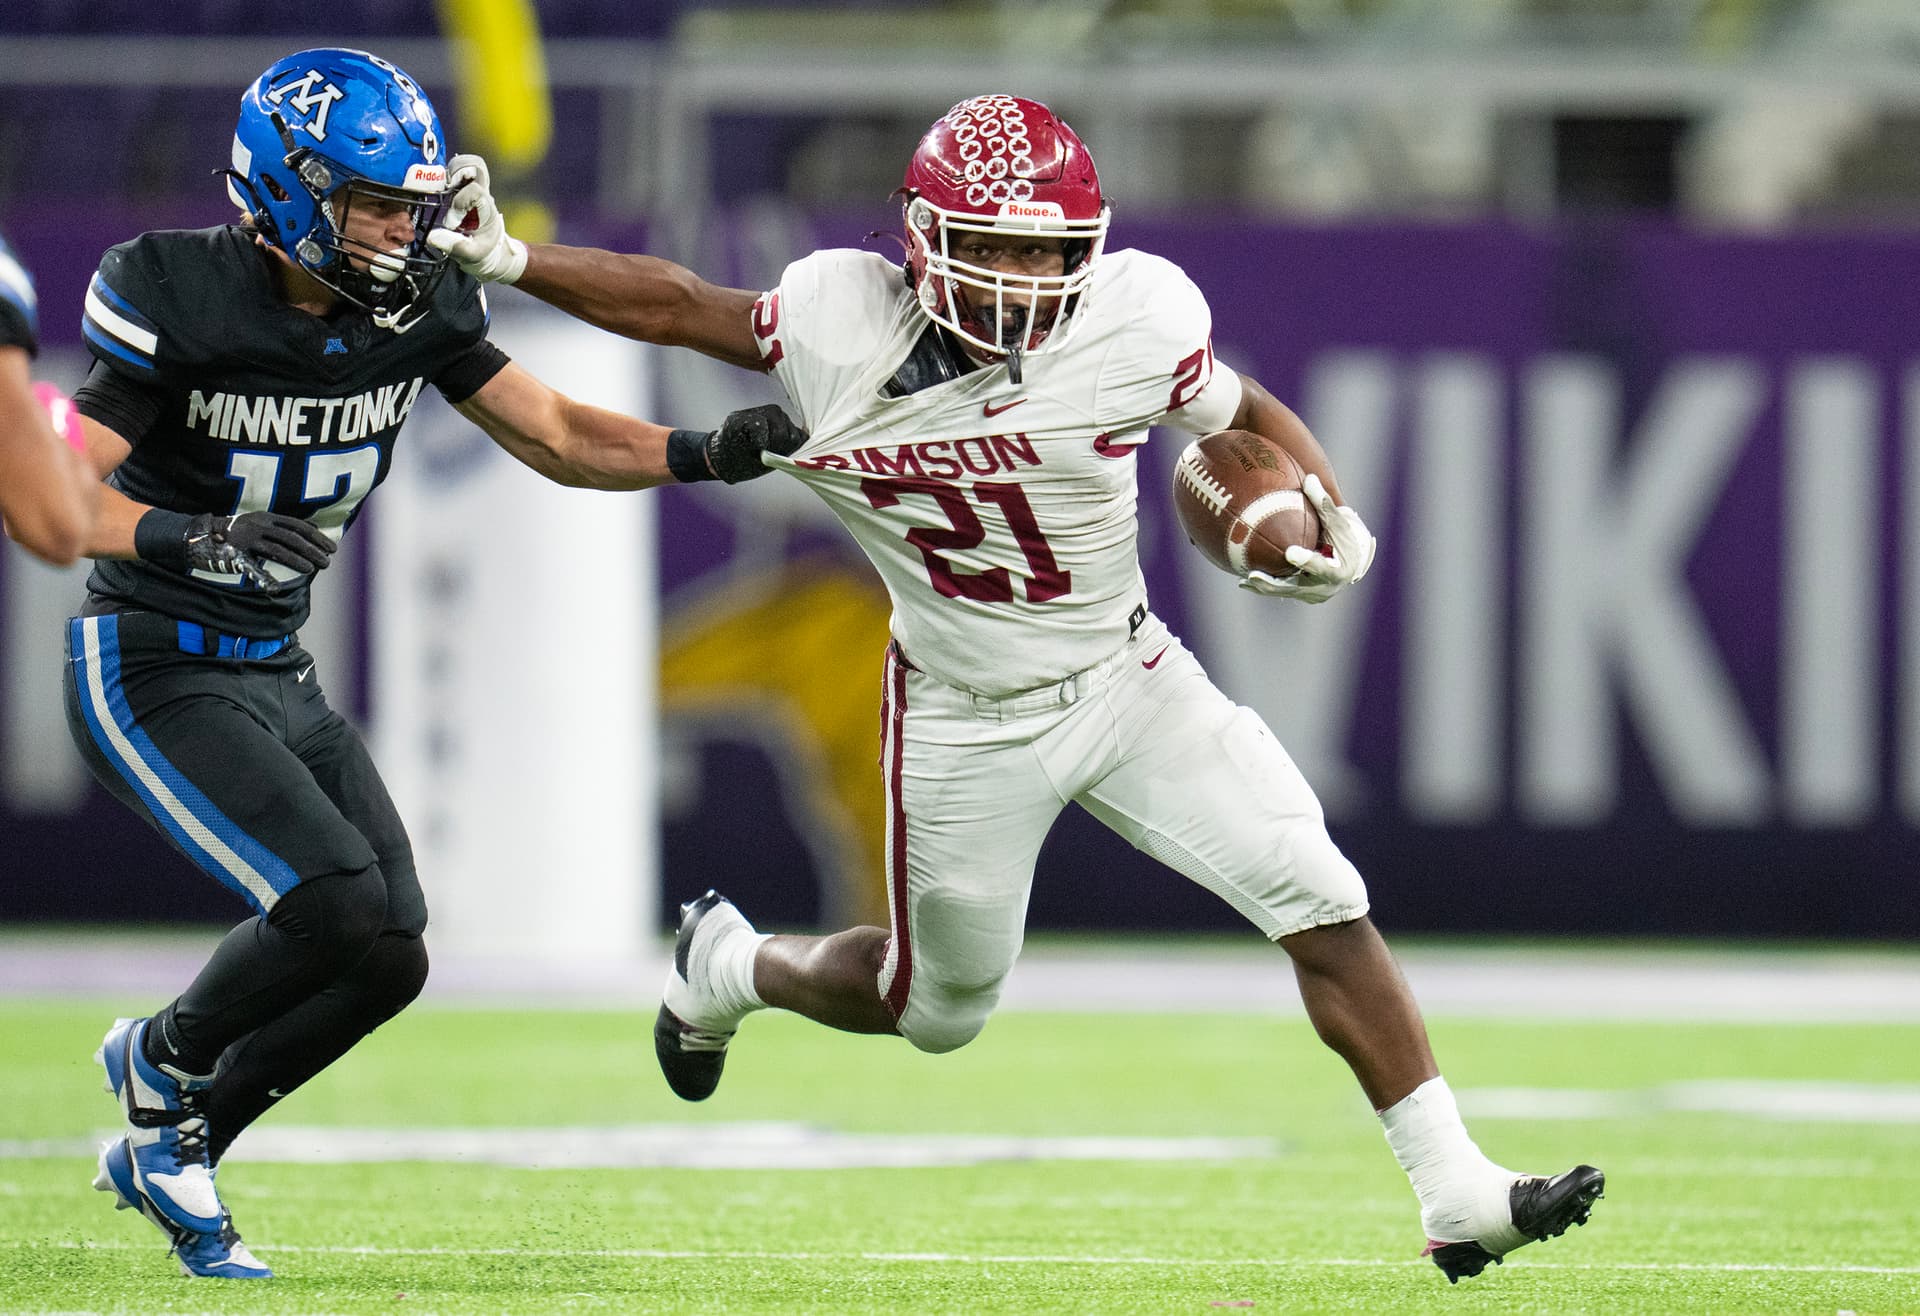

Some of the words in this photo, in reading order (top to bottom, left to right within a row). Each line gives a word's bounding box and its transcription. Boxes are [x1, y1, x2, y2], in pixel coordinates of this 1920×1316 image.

[266, 69, 344, 143] M
[186, 377, 423, 445] MINNETONKA
[1166, 328, 1213, 414] 2
[793, 432, 1043, 480] RIMSON
[859, 476, 1072, 604] 21
[1155, 350, 1920, 825] VIKI
